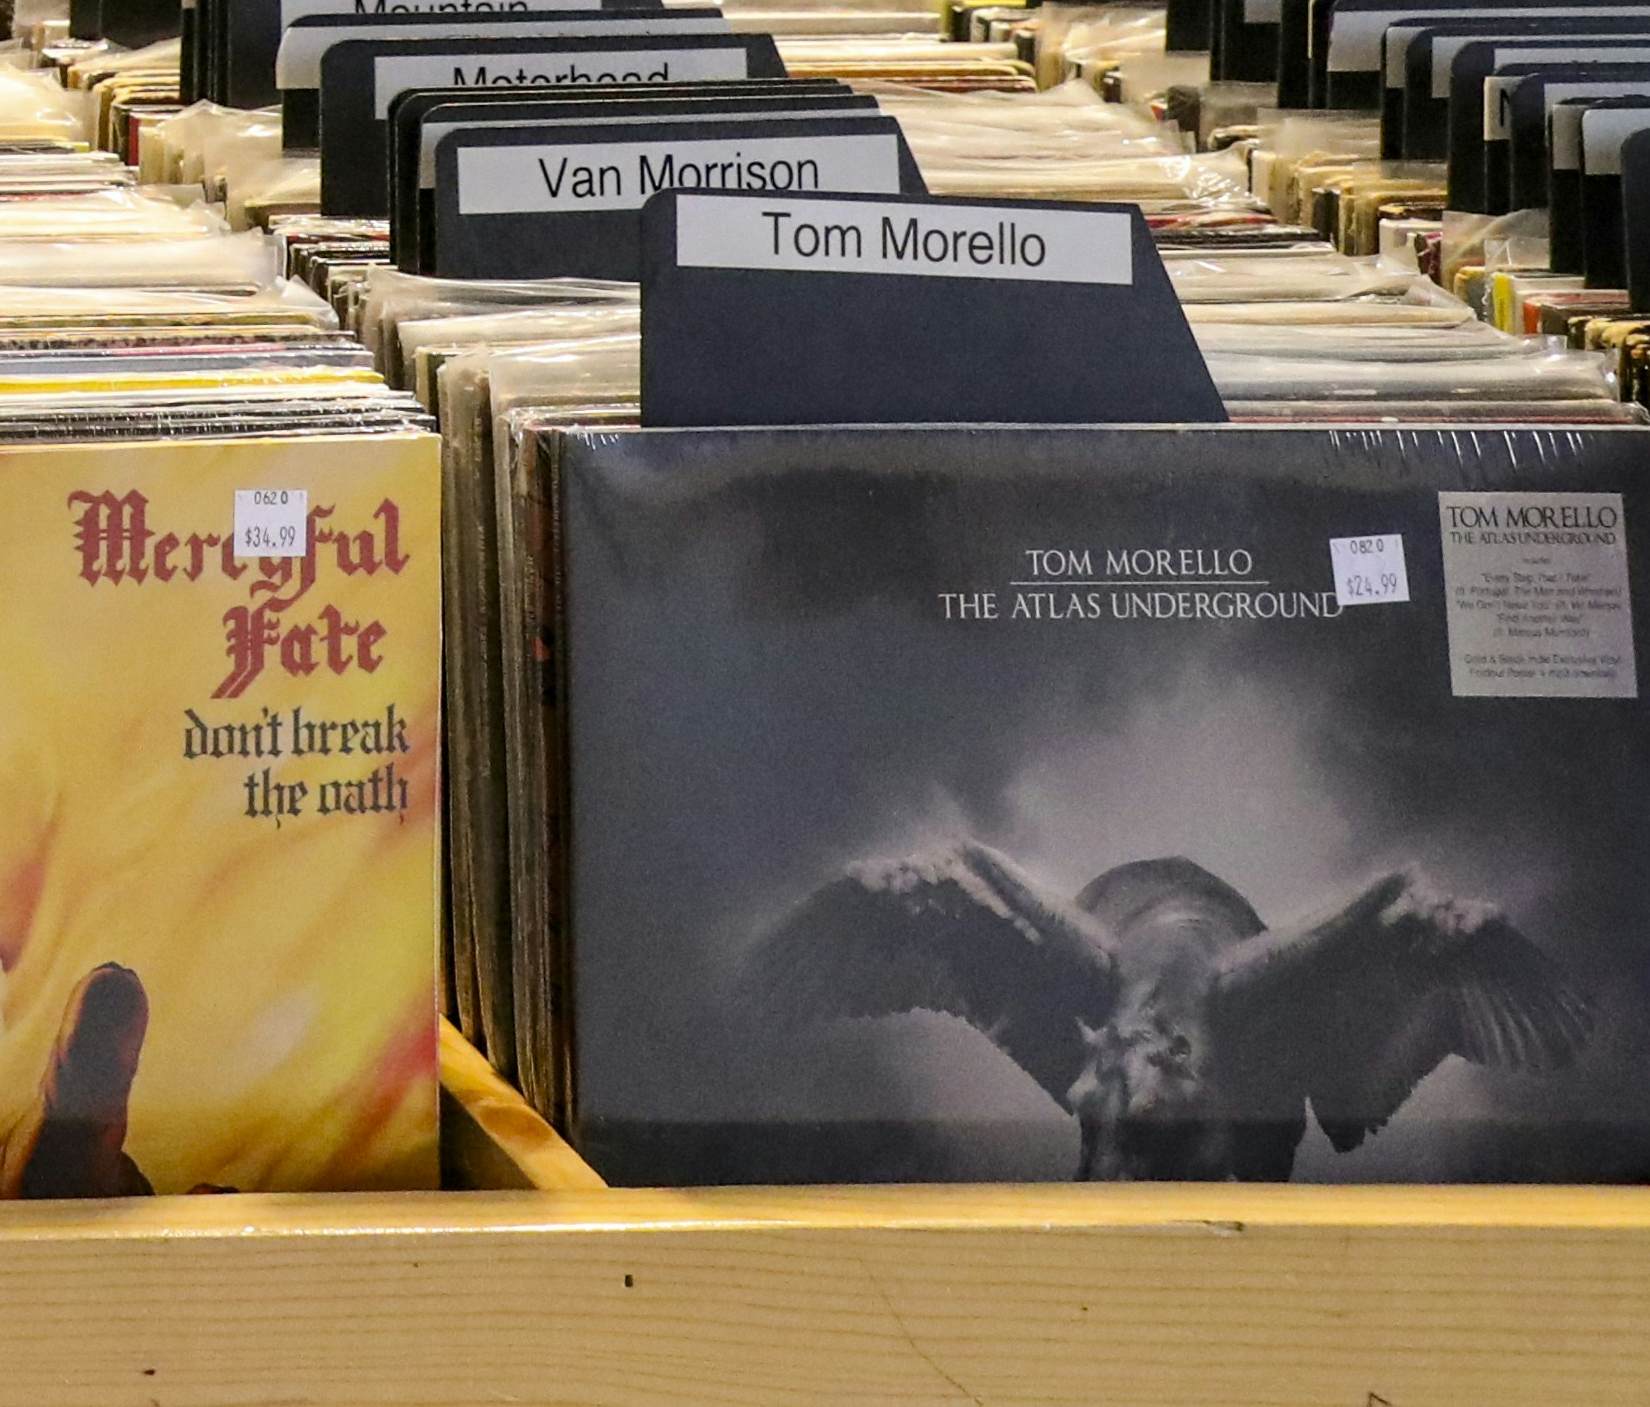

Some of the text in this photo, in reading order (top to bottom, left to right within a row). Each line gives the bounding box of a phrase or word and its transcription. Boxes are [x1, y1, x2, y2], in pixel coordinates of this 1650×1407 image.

[539, 151, 820, 199] Van Morrison
[761, 211, 1048, 268] Tom Morello
[244, 525, 297, 549] $34.99
[1445, 505, 1619, 530] TOM MORELLO
[1024, 547, 1255, 578] TOM MORELLO
[937, 587, 1343, 622] THE ATLAS UNDERGROUND
[1346, 573, 1400, 599] $24.99
[209, 603, 390, 700] Fate
[183, 702, 412, 760] don't break
[243, 762, 410, 830] the oath
